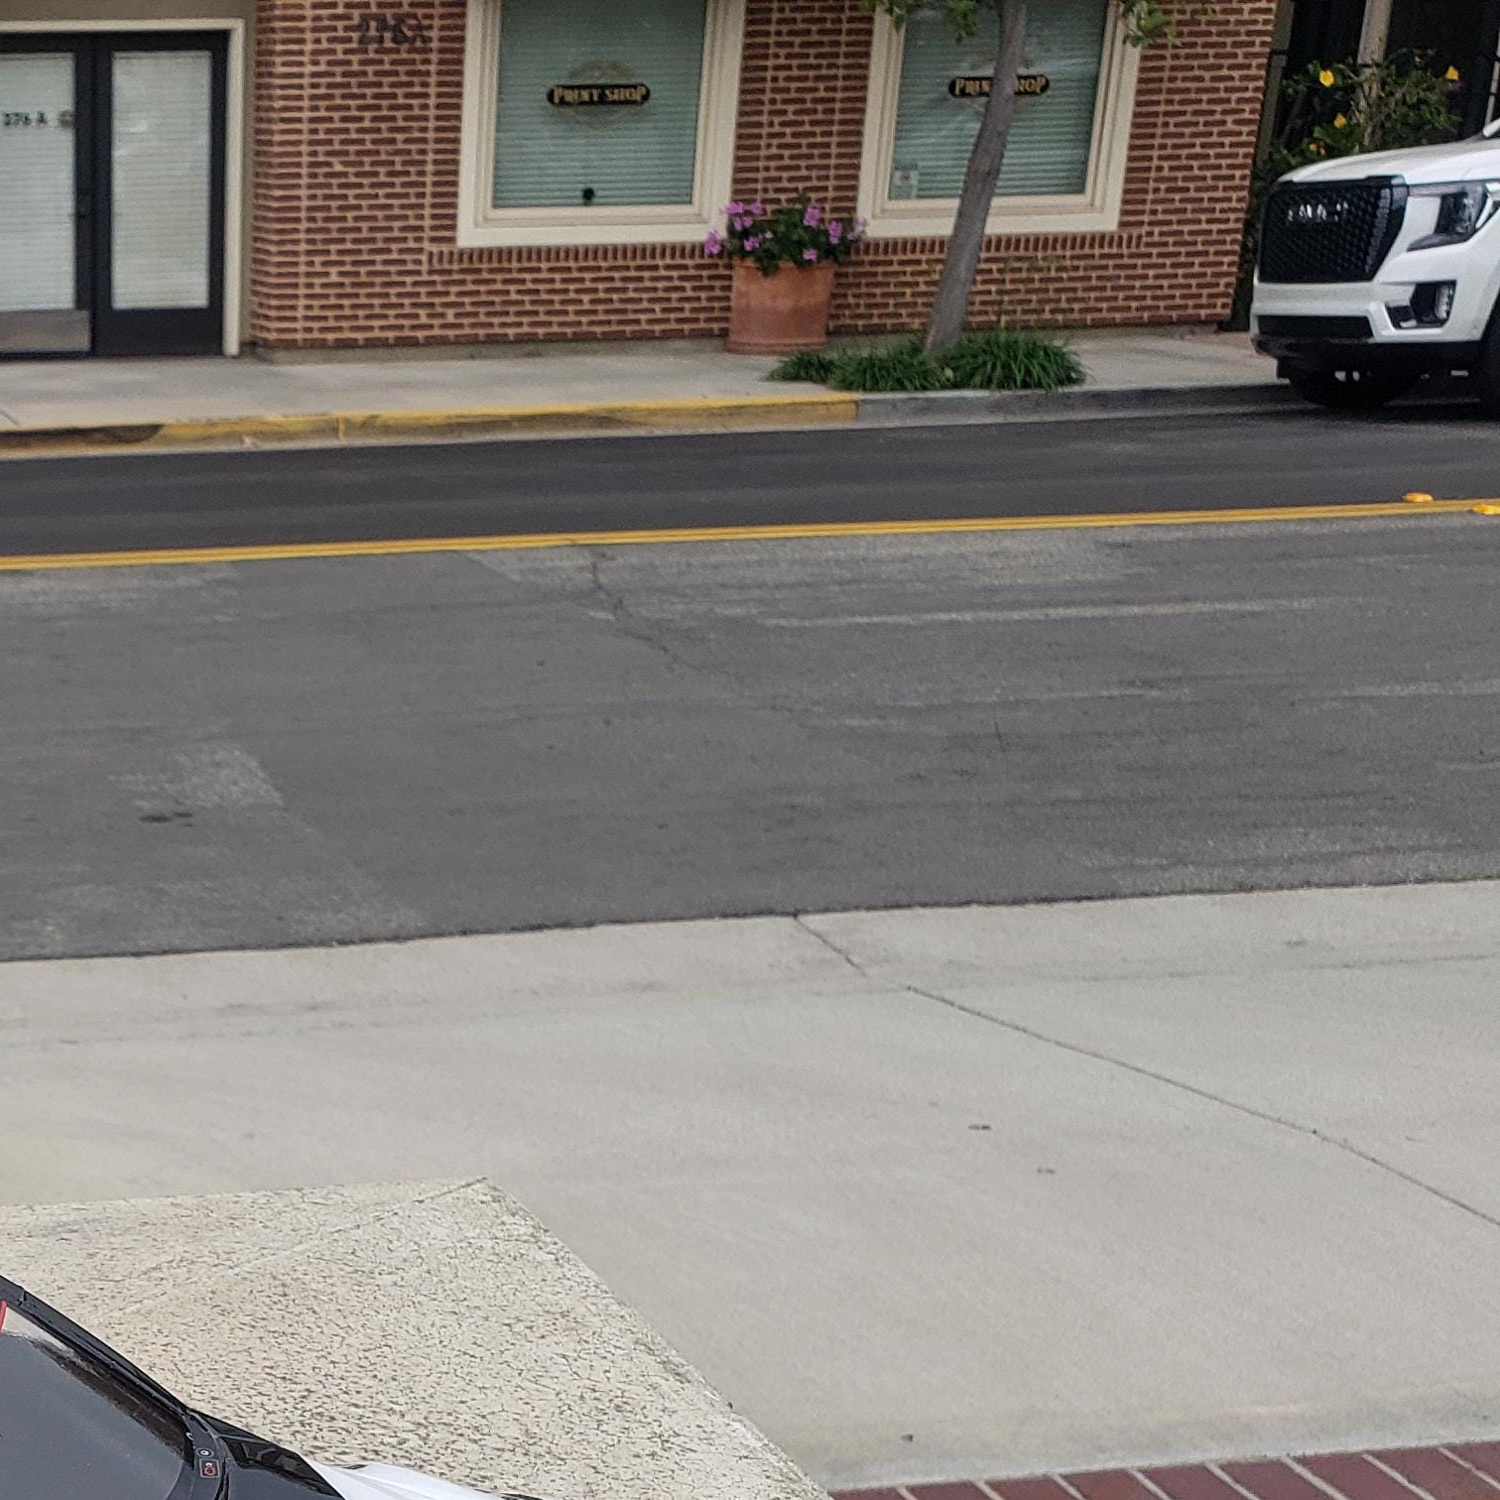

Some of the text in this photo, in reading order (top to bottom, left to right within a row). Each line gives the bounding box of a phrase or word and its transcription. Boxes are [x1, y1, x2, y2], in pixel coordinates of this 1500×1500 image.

[605, 84, 646, 103] SHOP
[954, 75, 1046, 96] PRIN HOP
